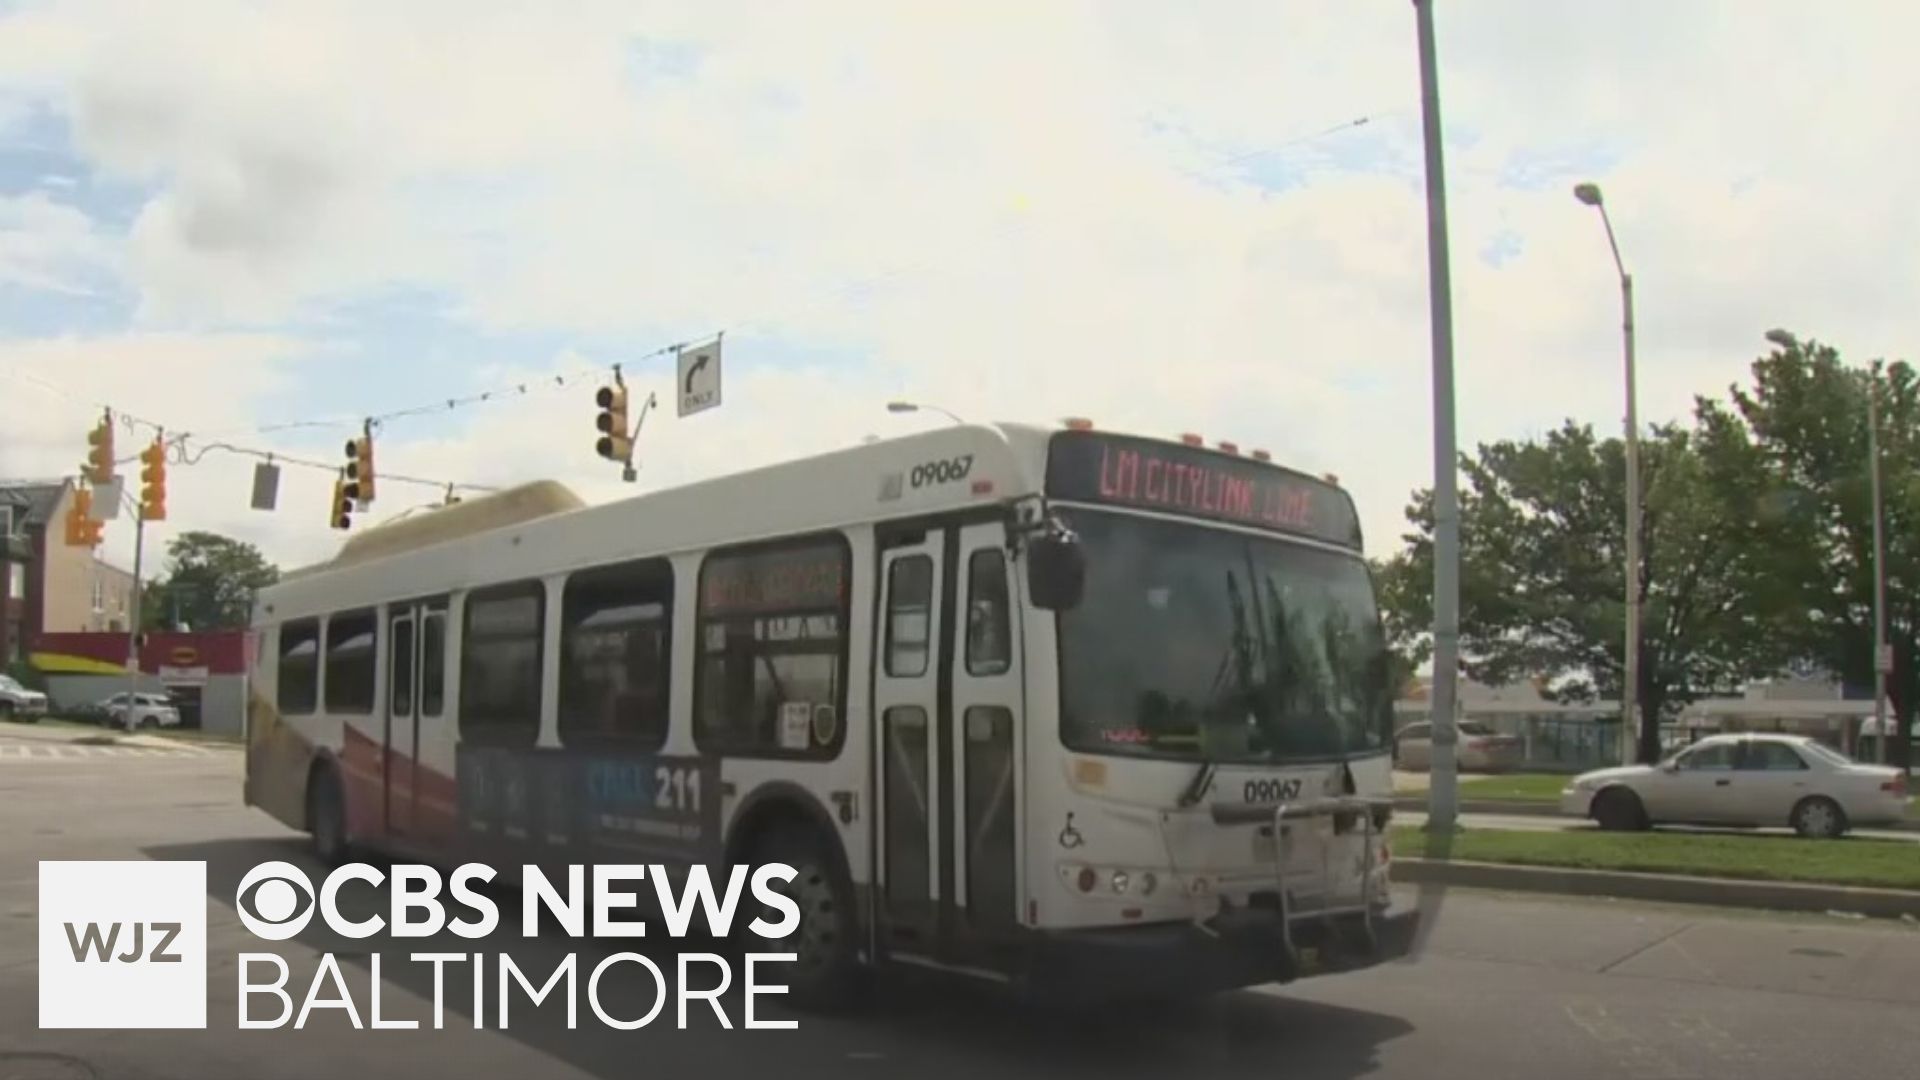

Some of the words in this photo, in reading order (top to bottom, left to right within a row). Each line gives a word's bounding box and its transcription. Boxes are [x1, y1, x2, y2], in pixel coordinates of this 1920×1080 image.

[684, 390, 714, 409] ONLY
[911, 453, 974, 488] 09067
[1100, 445, 1139, 498] LM
[1145, 458, 1254, 518] CITYLINK
[655, 767, 700, 811] 211
[1244, 779, 1303, 804] 09067
